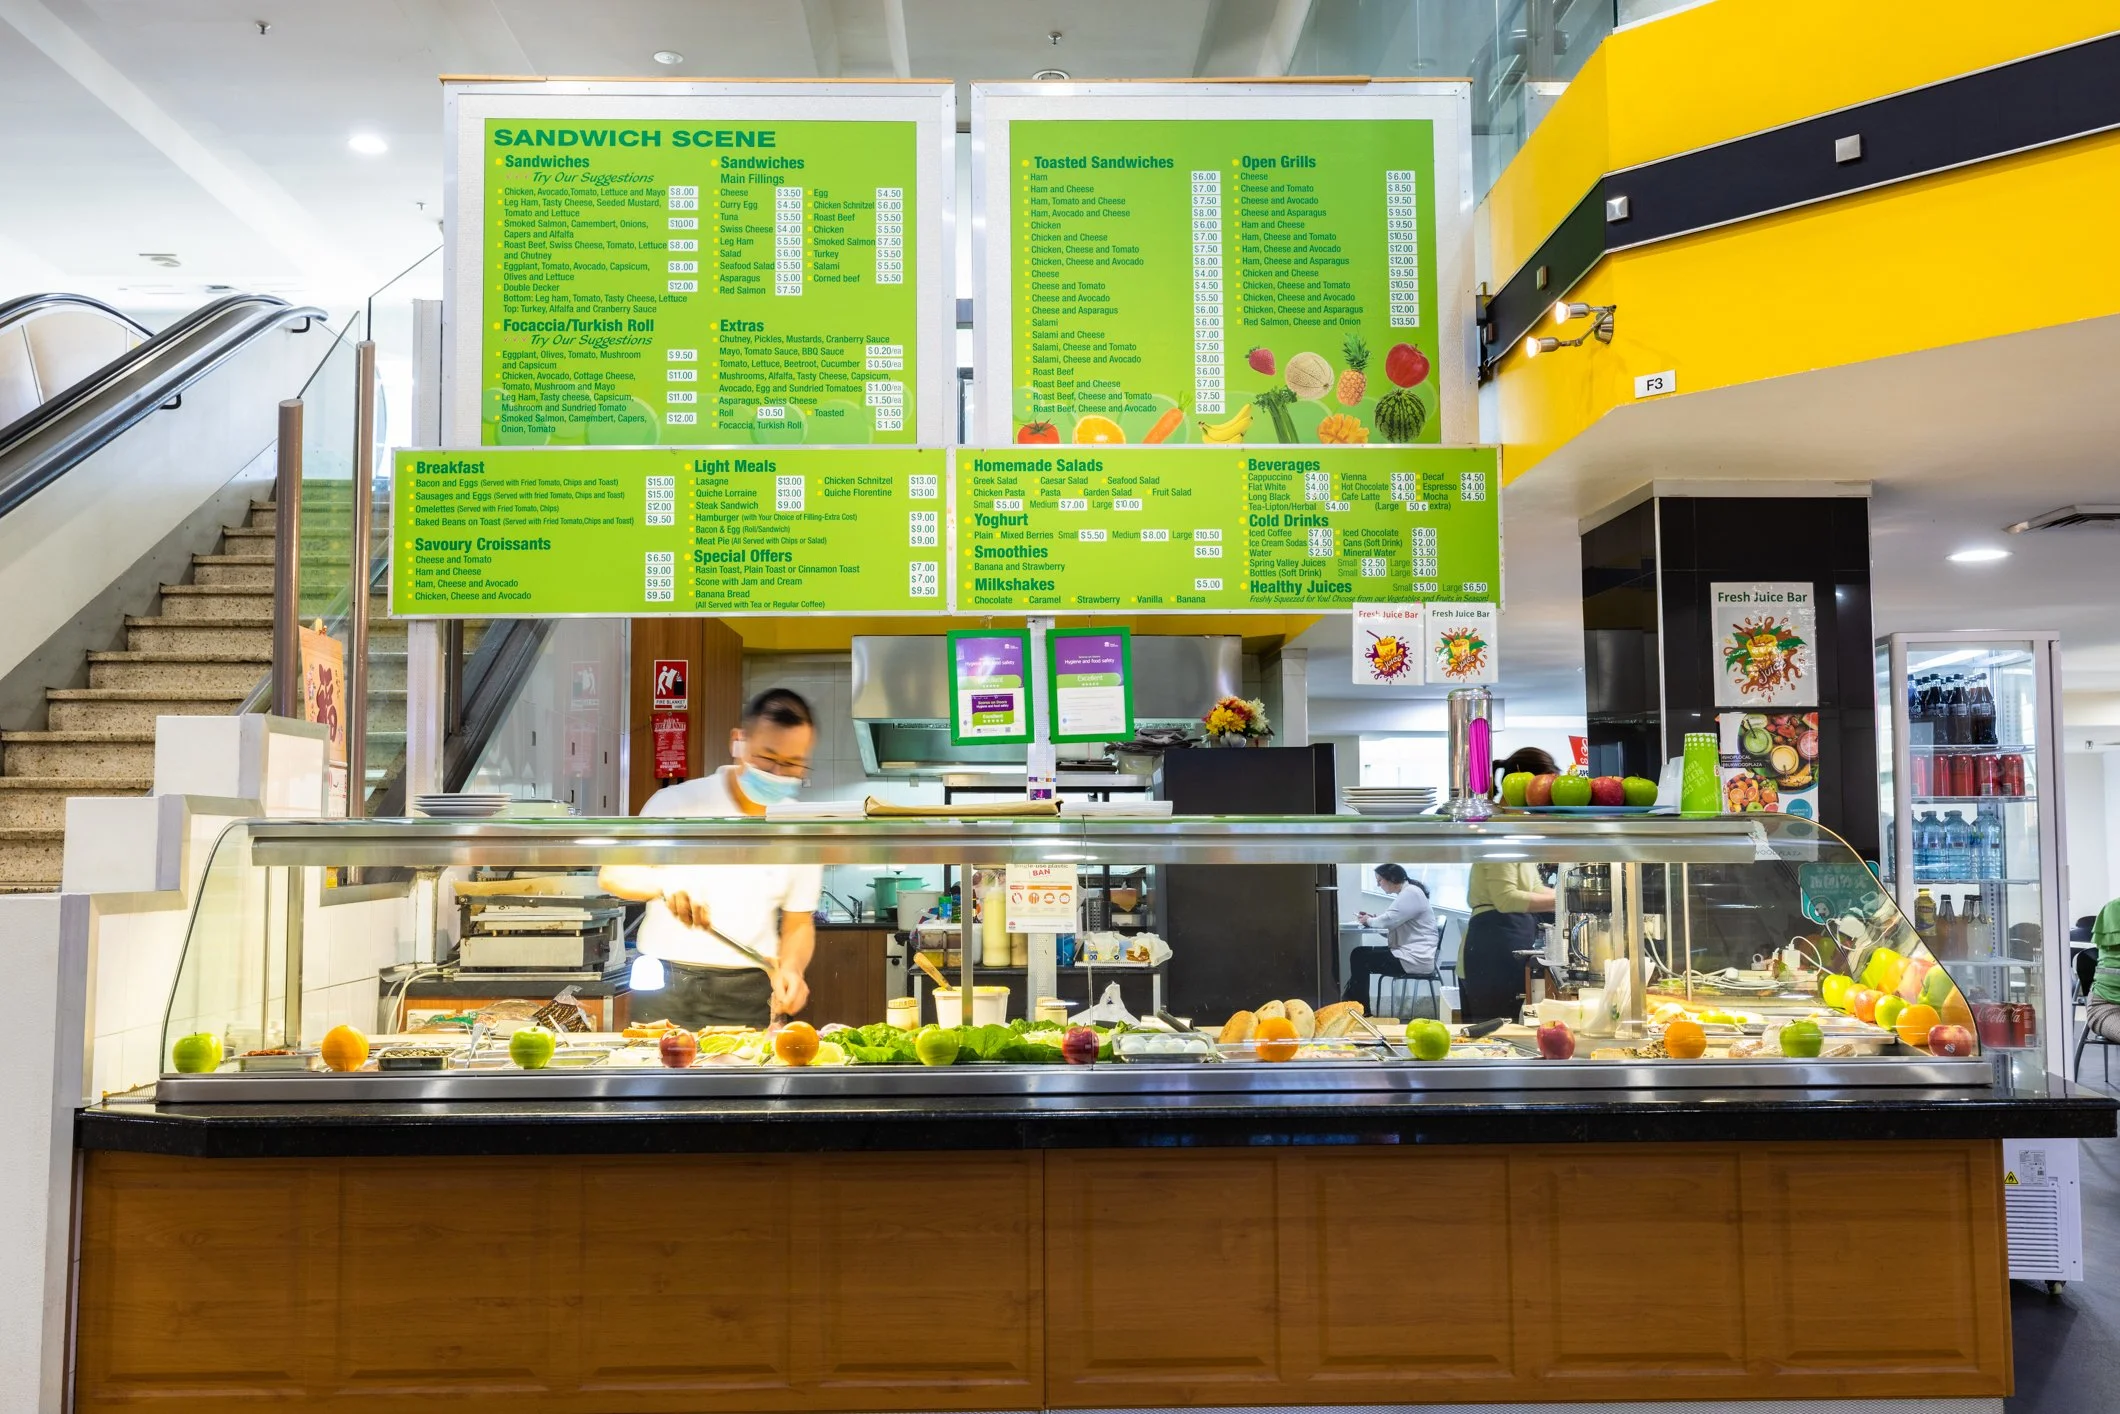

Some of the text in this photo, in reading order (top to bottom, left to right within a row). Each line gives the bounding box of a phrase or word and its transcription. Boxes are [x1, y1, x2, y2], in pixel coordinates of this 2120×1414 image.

[494, 129, 776, 148] SANDWICH SCENE
[505, 154, 590, 168] Sandwiches
[720, 156, 805, 169] Sandwiches
[1034, 156, 1174, 169] Toasted Sandwiches
[1242, 155, 1316, 170] Open Grills
[533, 171, 654, 187] Try Our Suggestions
[720, 173, 784, 185] Main Fillings
[1030, 173, 1048, 181] Ham
[1192, 172, 1217, 181] $6.00
[1240, 172, 1268, 181] Cheese
[1387, 172, 1412, 181] $6.00
[720, 188, 749, 197] Cheese
[814, 188, 829, 199] Egg
[877, 188, 902, 199] $4.50
[813, 200, 875, 210] Chicken Schnitzel
[877, 200, 902, 211] $6.00
[720, 212, 739, 221] Tuna
[1031, 221, 1062, 230] Chicken
[504, 229, 574, 239] Capers and Alfalfa
[1242, 232, 1337, 241] Ham, Cheese and Tomato
[1389, 232, 1414, 242] $10.50
[720, 249, 742, 258] Salad
[813, 250, 839, 260] Turkey
[813, 274, 860, 283] Corned beef
[503, 283, 560, 292] Double Decker
[669, 281, 695, 292] $12.00
[503, 318, 654, 333] Focaccia/Turkish Roll
[720, 319, 764, 332] Extras
[1032, 318, 1058, 327] Salami
[1244, 317, 1361, 326] Red Salmon, Cheese and Onion
[1391, 317, 1416, 327] $13.50
[1032, 367, 1074, 376] Roast Beef
[1646, 377, 1663, 391] F3
[814, 408, 845, 417] Toasted
[416, 461, 485, 474] Breakfast
[694, 459, 776, 475] Light Meals
[974, 459, 1103, 472] Homemade Salads
[1248, 459, 1320, 472] Beverages
[777, 477, 802, 486] $13.00
[973, 477, 1018, 485] Greek Salad
[1067, 477, 1088, 485] Salad
[1107, 476, 1160, 485] Seafood Salad
[1248, 473, 1293, 482] Cappuccino
[1305, 473, 1329, 482] $4.00
[1340, 473, 1367, 481] Vienna
[1422, 473, 1444, 481] Decaf
[416, 479, 479, 488] Bacon and Eggs
[647, 478, 674, 487] $15.00
[696, 477, 729, 487] Lasagne
[1422, 483, 1458, 492] Espresso
[696, 489, 757, 498] Quiche Lorraine
[1360, 493, 1380, 501] Latte
[415, 505, 455, 513] Omelettes
[696, 501, 759, 510] Steak Sandwich
[777, 501, 802, 509] $9.00
[415, 517, 440, 526] Baked
[441, 518, 466, 526] Beans
[480, 517, 501, 526] Toast
[647, 515, 672, 524] $9.50
[696, 513, 739, 523] Hamburger
[974, 513, 1028, 529] Yoghurt
[1249, 514, 1329, 527] Cold Drinks
[974, 531, 994, 539] Plain
[1000, 531, 1054, 539] Mixed Berries
[1249, 529, 1292, 537] Iced Coffee
[1308, 529, 1332, 537] $7.00
[415, 537, 551, 552] Savoury Croissants
[974, 545, 1048, 558] Smoothies
[1196, 547, 1220, 556] $6.50
[1412, 548, 1436, 556] $3.50
[415, 555, 492, 564] Cheese and Tomato
[694, 550, 792, 564] Special Offers
[695, 577, 803, 586] Scone with Jam and Cream
[975, 578, 1055, 591] Milkshakes
[1196, 580, 1221, 589] $5.00
[911, 587, 935, 596] $9.50
[1250, 580, 1352, 595] Healthy Juices
[695, 590, 750, 598] Banana Bread
[1718, 591, 1807, 603] Fresh Juice Bar
[974, 596, 1013, 604] Chocolate
[1029, 596, 1061, 604] Caramel
[1077, 595, 1120, 605] Strawberry
[1137, 595, 1163, 603] Vanilla
[1176, 595, 1206, 603] Banana
[1383, 611, 1403, 619] Juice
[1404, 611, 1419, 619] Bar
[1432, 609, 1490, 618] Fresh Juice Bar
